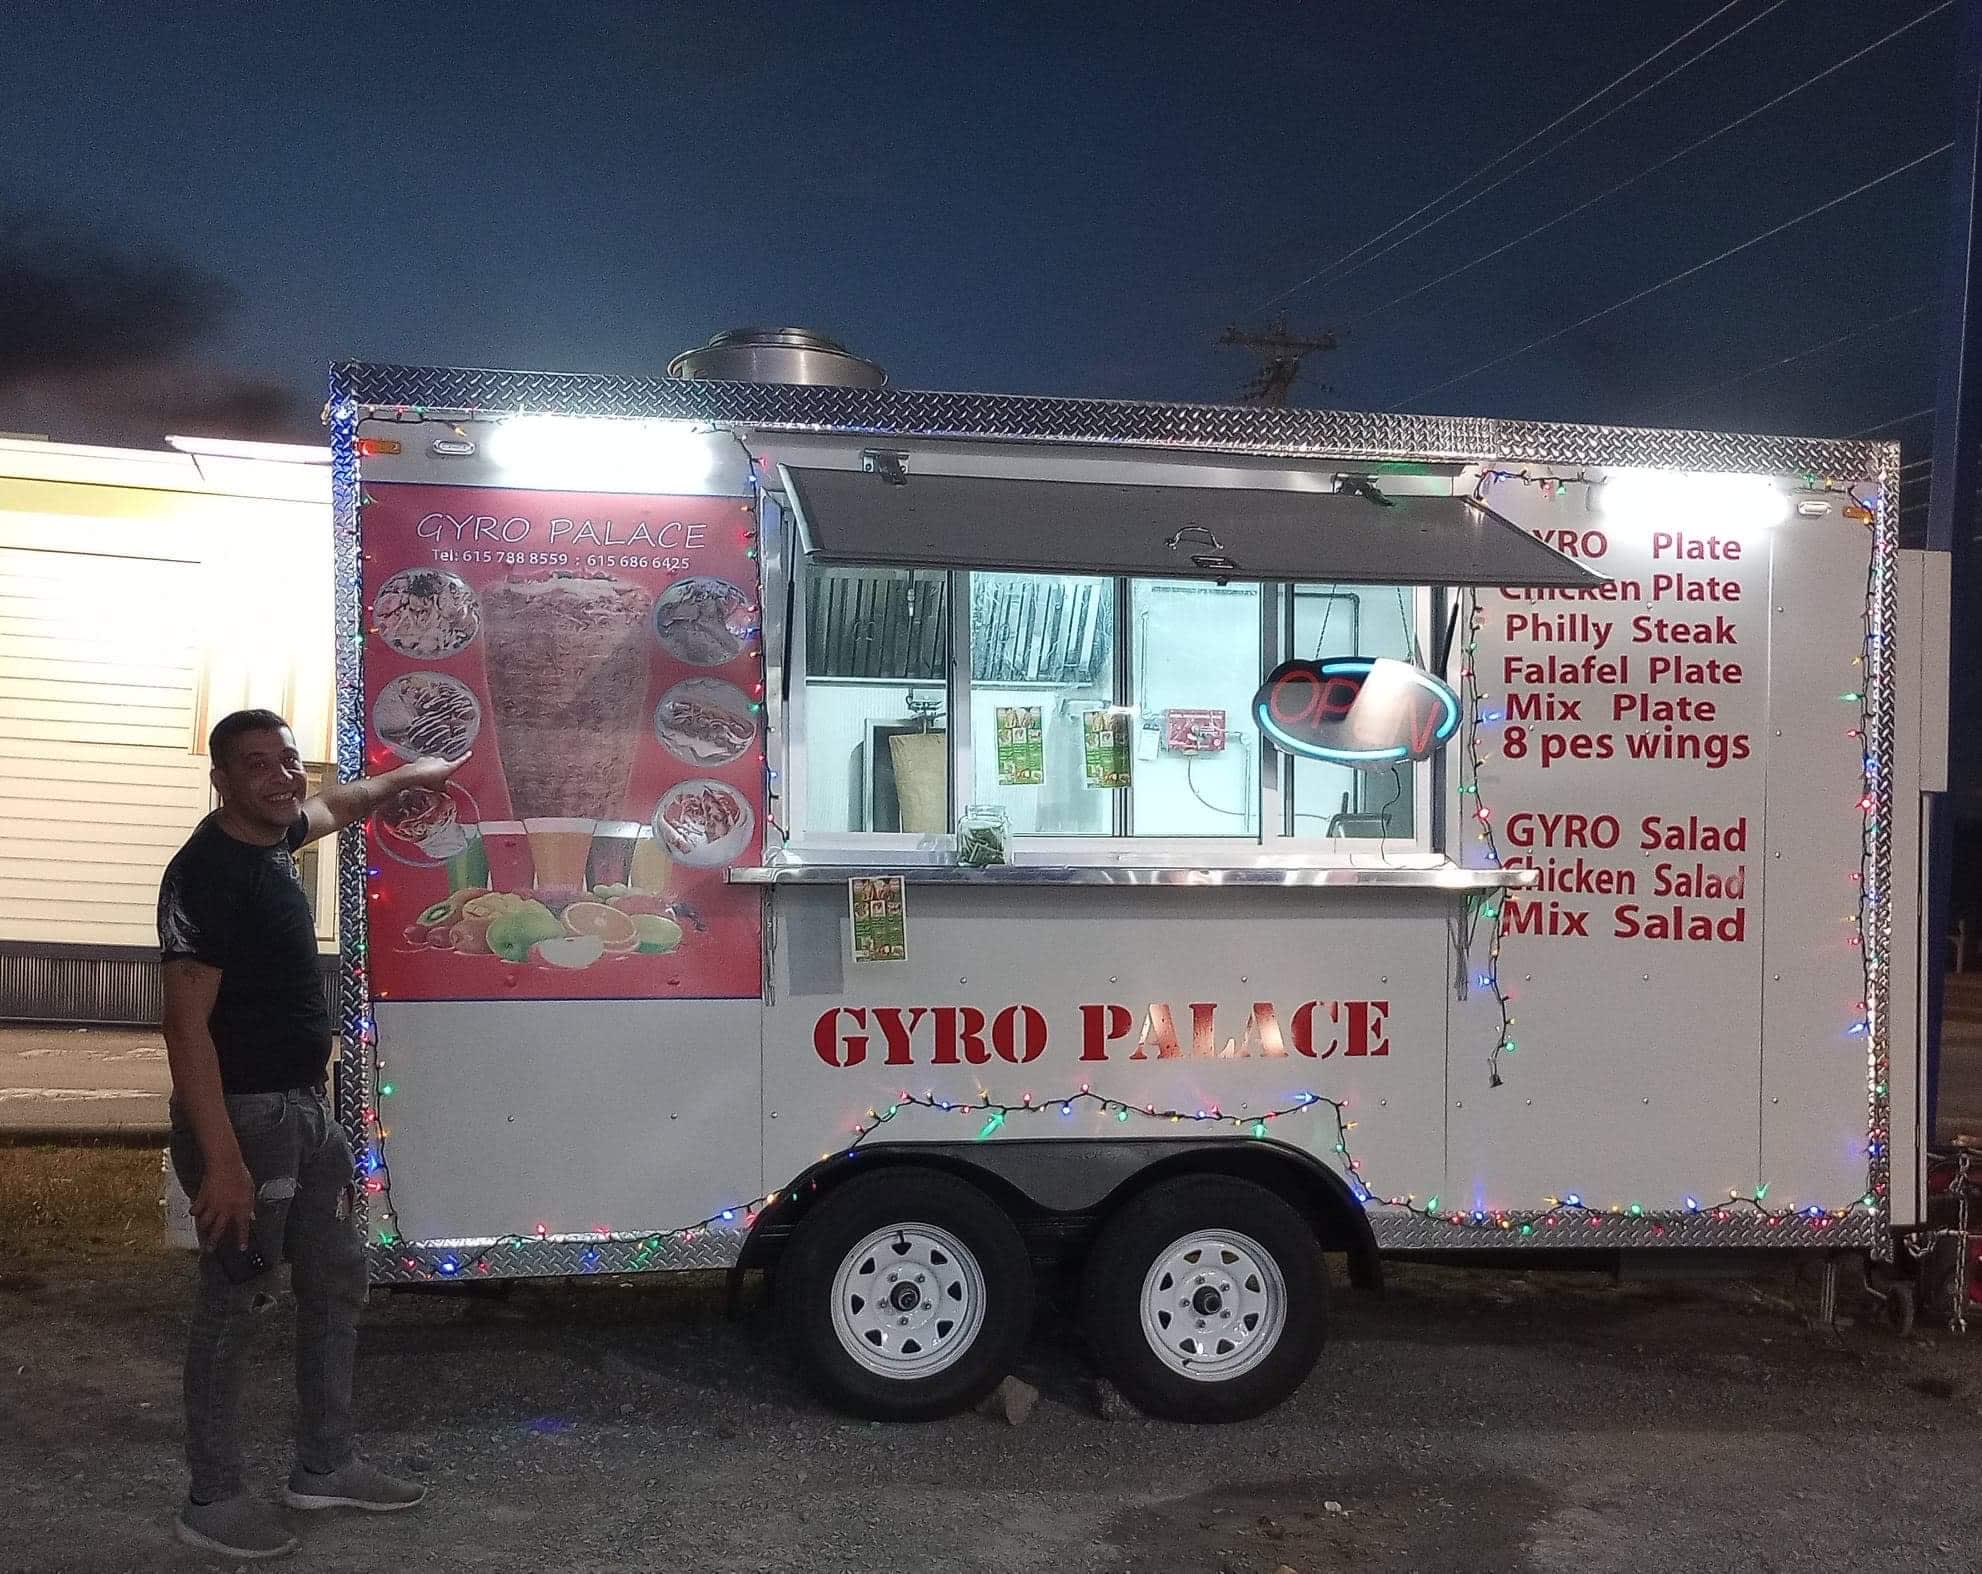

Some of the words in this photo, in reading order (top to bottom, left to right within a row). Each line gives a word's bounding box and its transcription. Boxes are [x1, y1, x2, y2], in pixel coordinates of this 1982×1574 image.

[415, 513, 531, 543] GYRO
[550, 518, 707, 549] PALACE
[1652, 532, 1742, 560] Plate
[432, 548, 458, 562] Tel:
[462, 550, 492, 563] 615
[496, 551, 525, 564] 788
[529, 552, 568, 565] 8559
[587, 554, 615, 567] 615
[620, 556, 648, 568] 686
[652, 557, 690, 570] 6425
[1653, 573, 1741, 601] Plate
[1506, 613, 1613, 650] Philly
[1632, 616, 1738, 644] Steak
[1503, 655, 1628, 684] Falafel
[1650, 655, 1743, 684] Plate
[1505, 693, 1582, 721] Mix
[1612, 693, 1716, 722] Plate
[1502, 726, 1528, 760] 8
[1541, 732, 1615, 768] pes
[1625, 725, 1751, 769] wings
[1506, 813, 1620, 849] GYRO
[1640, 816, 1747, 851] Salad
[1654, 863, 1745, 899] Salad
[1502, 901, 1589, 937] Mix
[1614, 904, 1745, 942] Salad
[812, 1004, 1048, 1067] GYRO
[1078, 1001, 1390, 1061] PALACE
